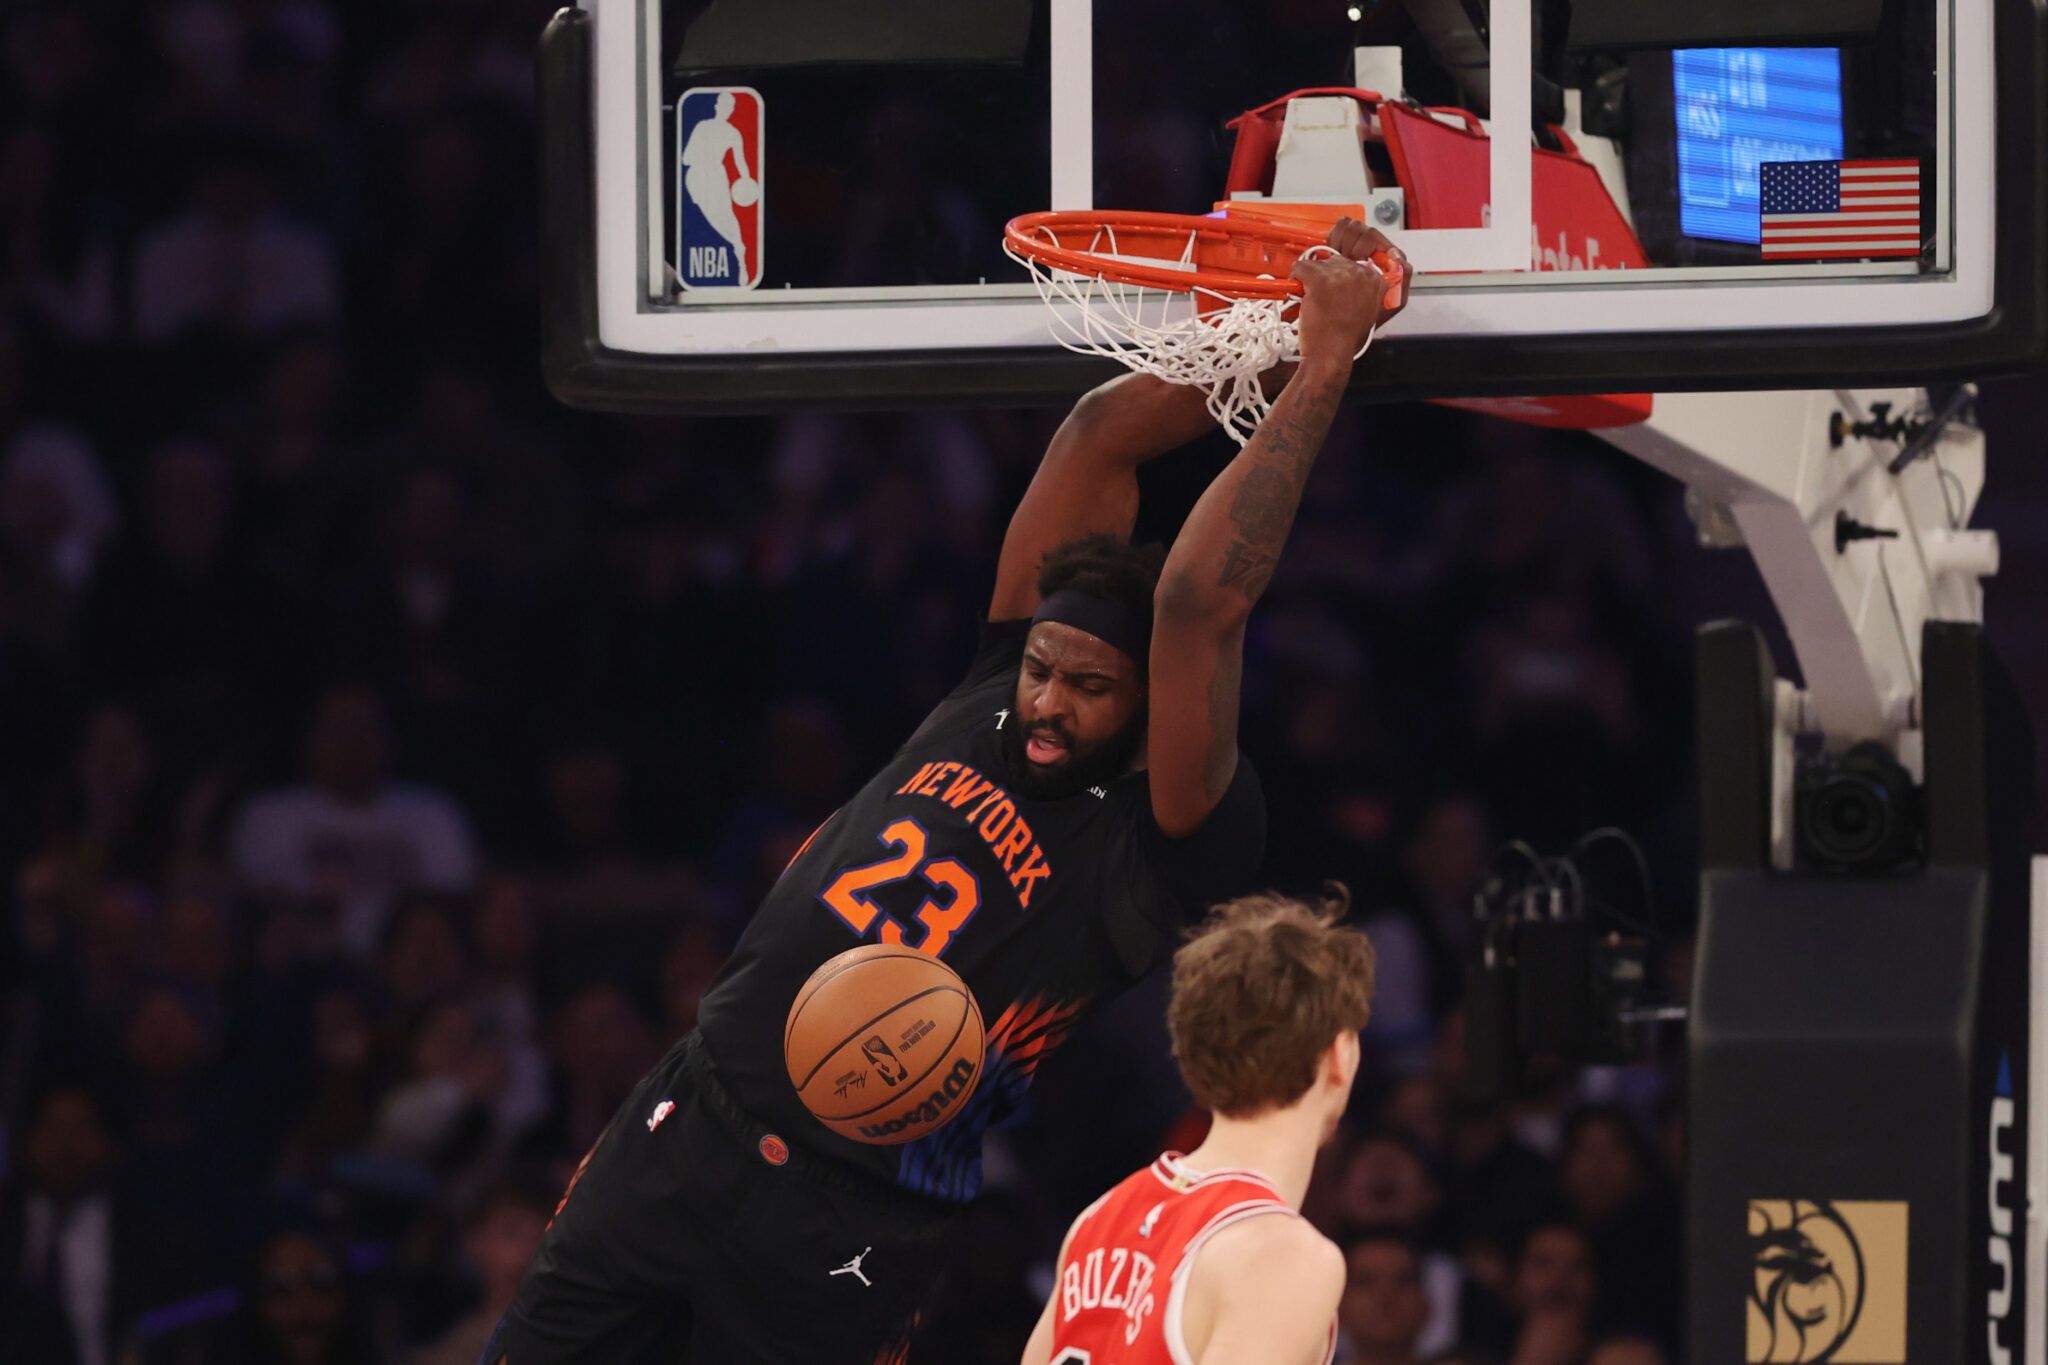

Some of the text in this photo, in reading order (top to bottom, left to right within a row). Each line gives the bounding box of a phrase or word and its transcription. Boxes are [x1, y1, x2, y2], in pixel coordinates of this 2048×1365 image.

[689, 246, 730, 278] NBA
[816, 815, 982, 957] 23
[894, 761, 1051, 910] NEW YORK
